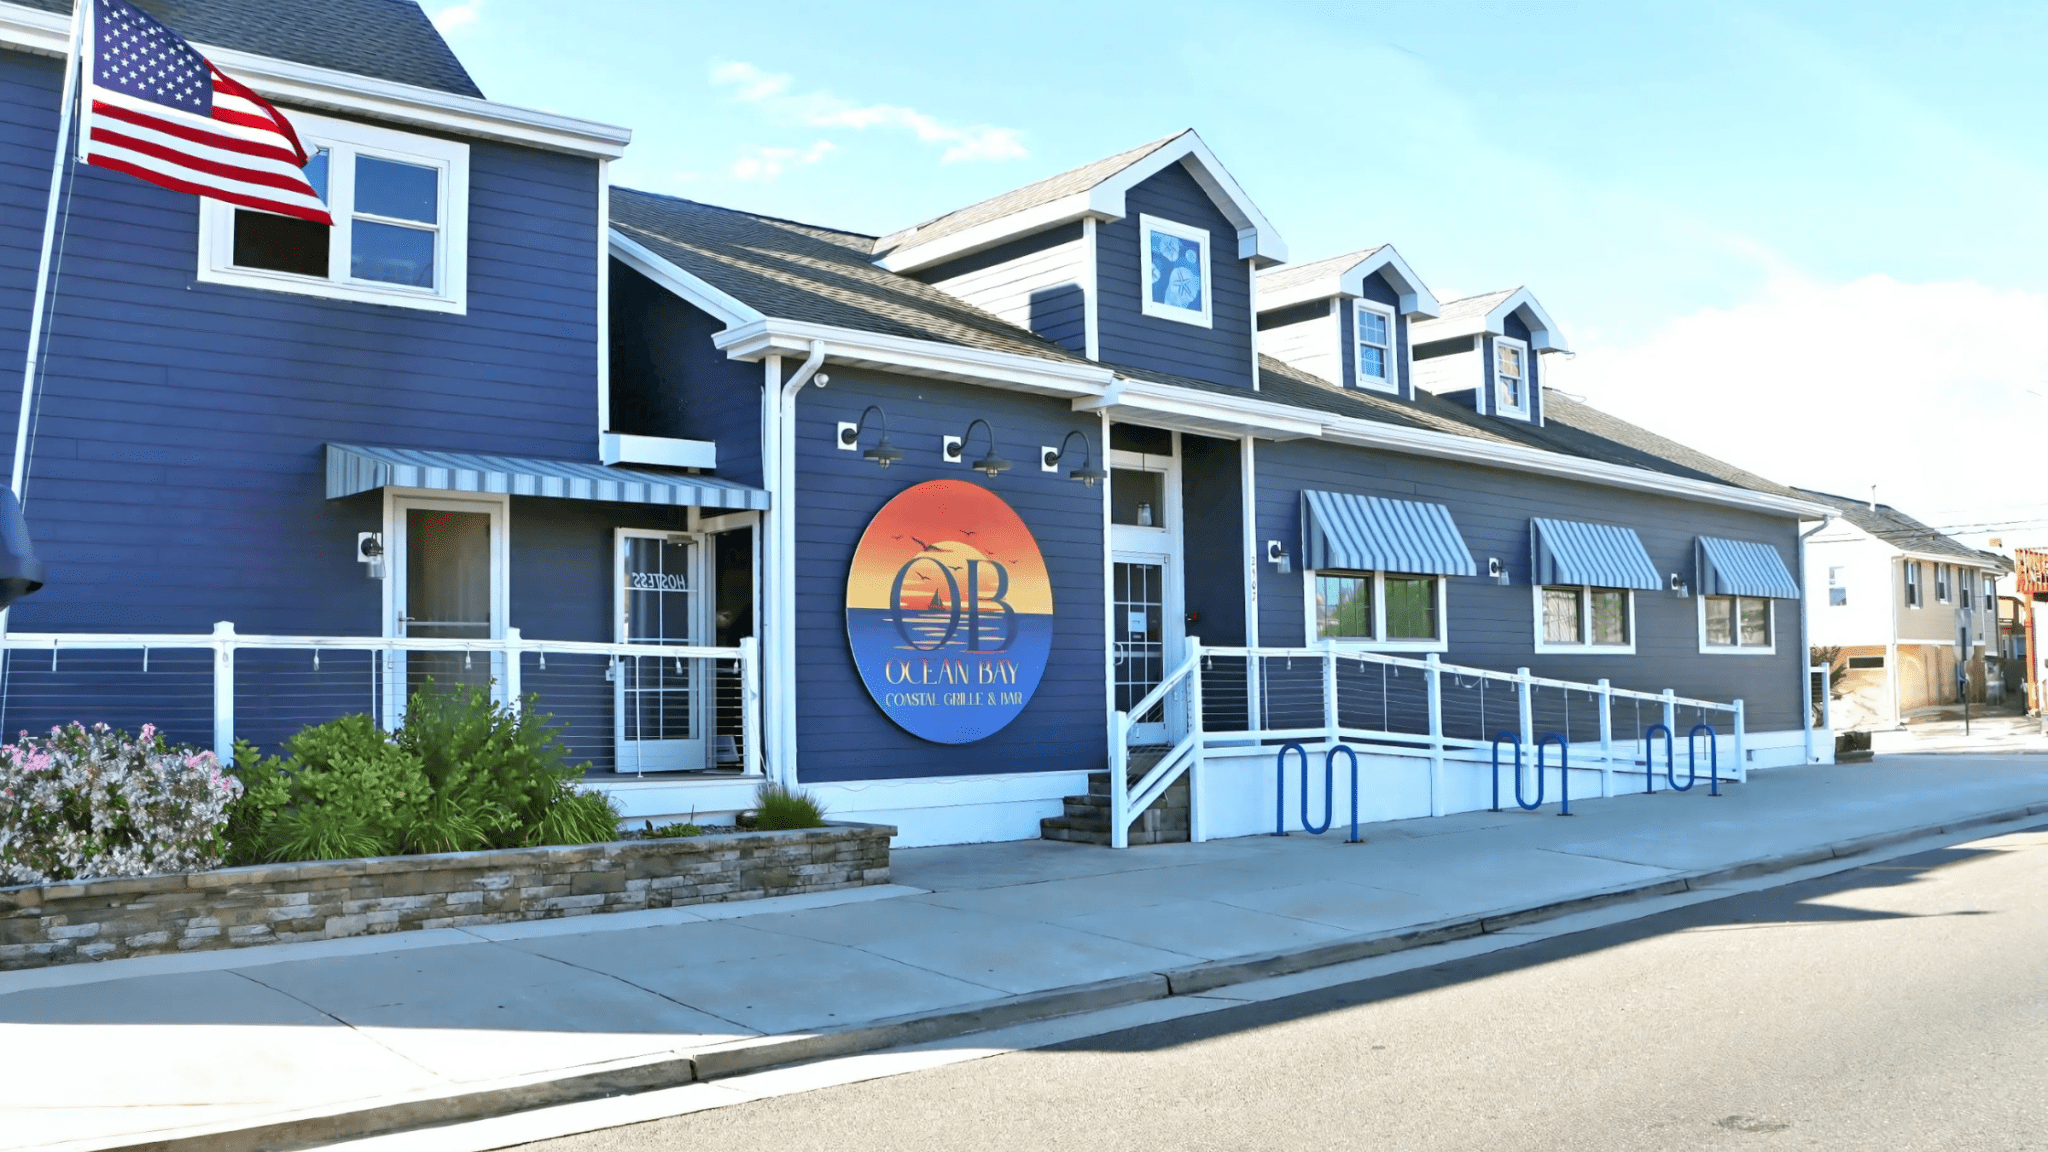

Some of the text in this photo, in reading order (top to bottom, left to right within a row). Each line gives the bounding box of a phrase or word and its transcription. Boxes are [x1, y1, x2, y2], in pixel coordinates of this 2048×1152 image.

[890, 556, 1018, 654] OB
[885, 658, 1019, 685] OCEAN BAY
[885, 691, 1022, 707] COASTAL GRILLE & BAR
